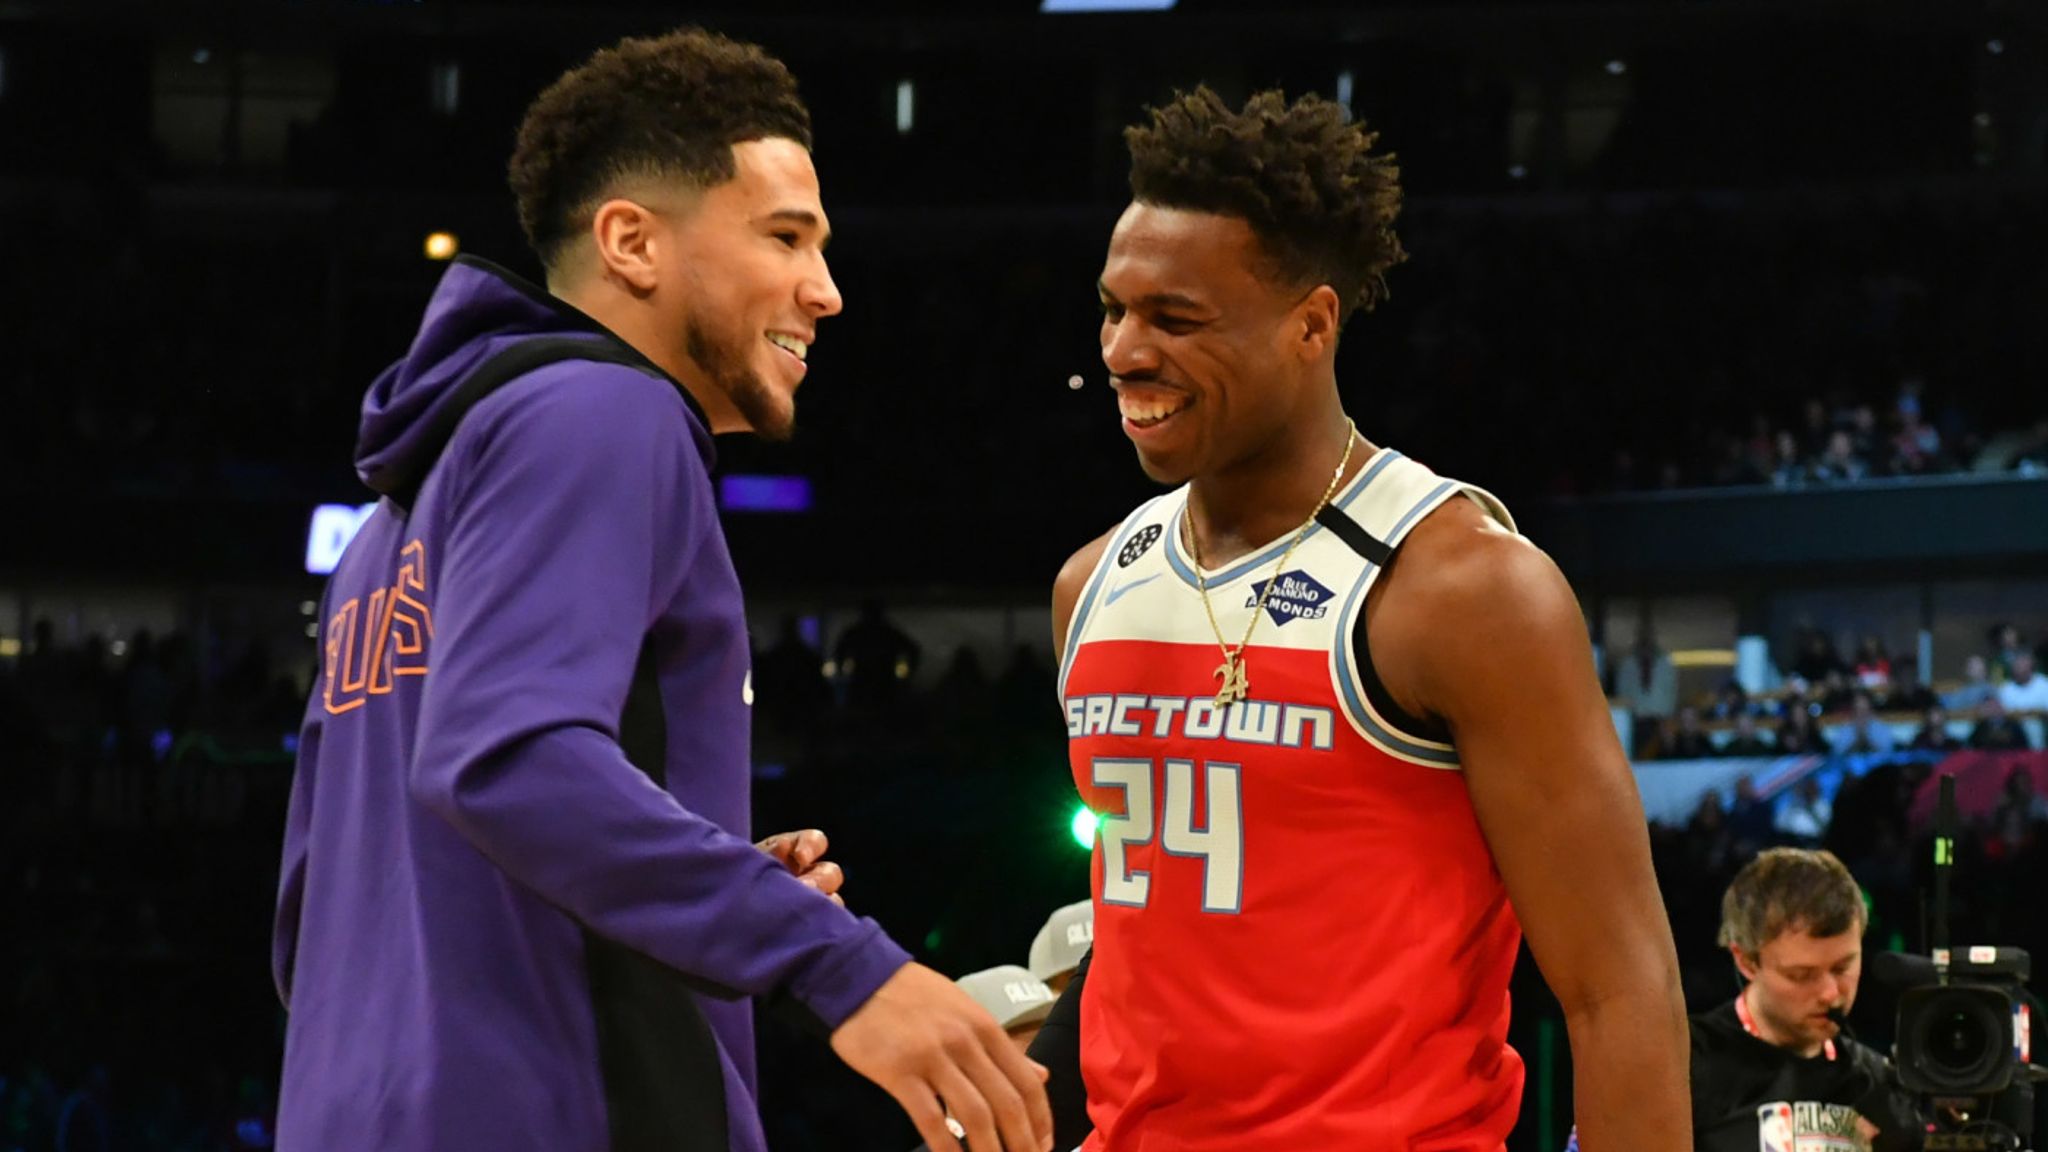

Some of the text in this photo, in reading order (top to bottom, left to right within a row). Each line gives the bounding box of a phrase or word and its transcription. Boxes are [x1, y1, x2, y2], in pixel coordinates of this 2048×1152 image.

[1246, 596, 1325, 619] AMONDS
[1281, 576, 1309, 592] BLUE
[1213, 658, 1249, 709] 24
[1065, 694, 1334, 749] SACTOWN
[1092, 757, 1244, 914] 24
